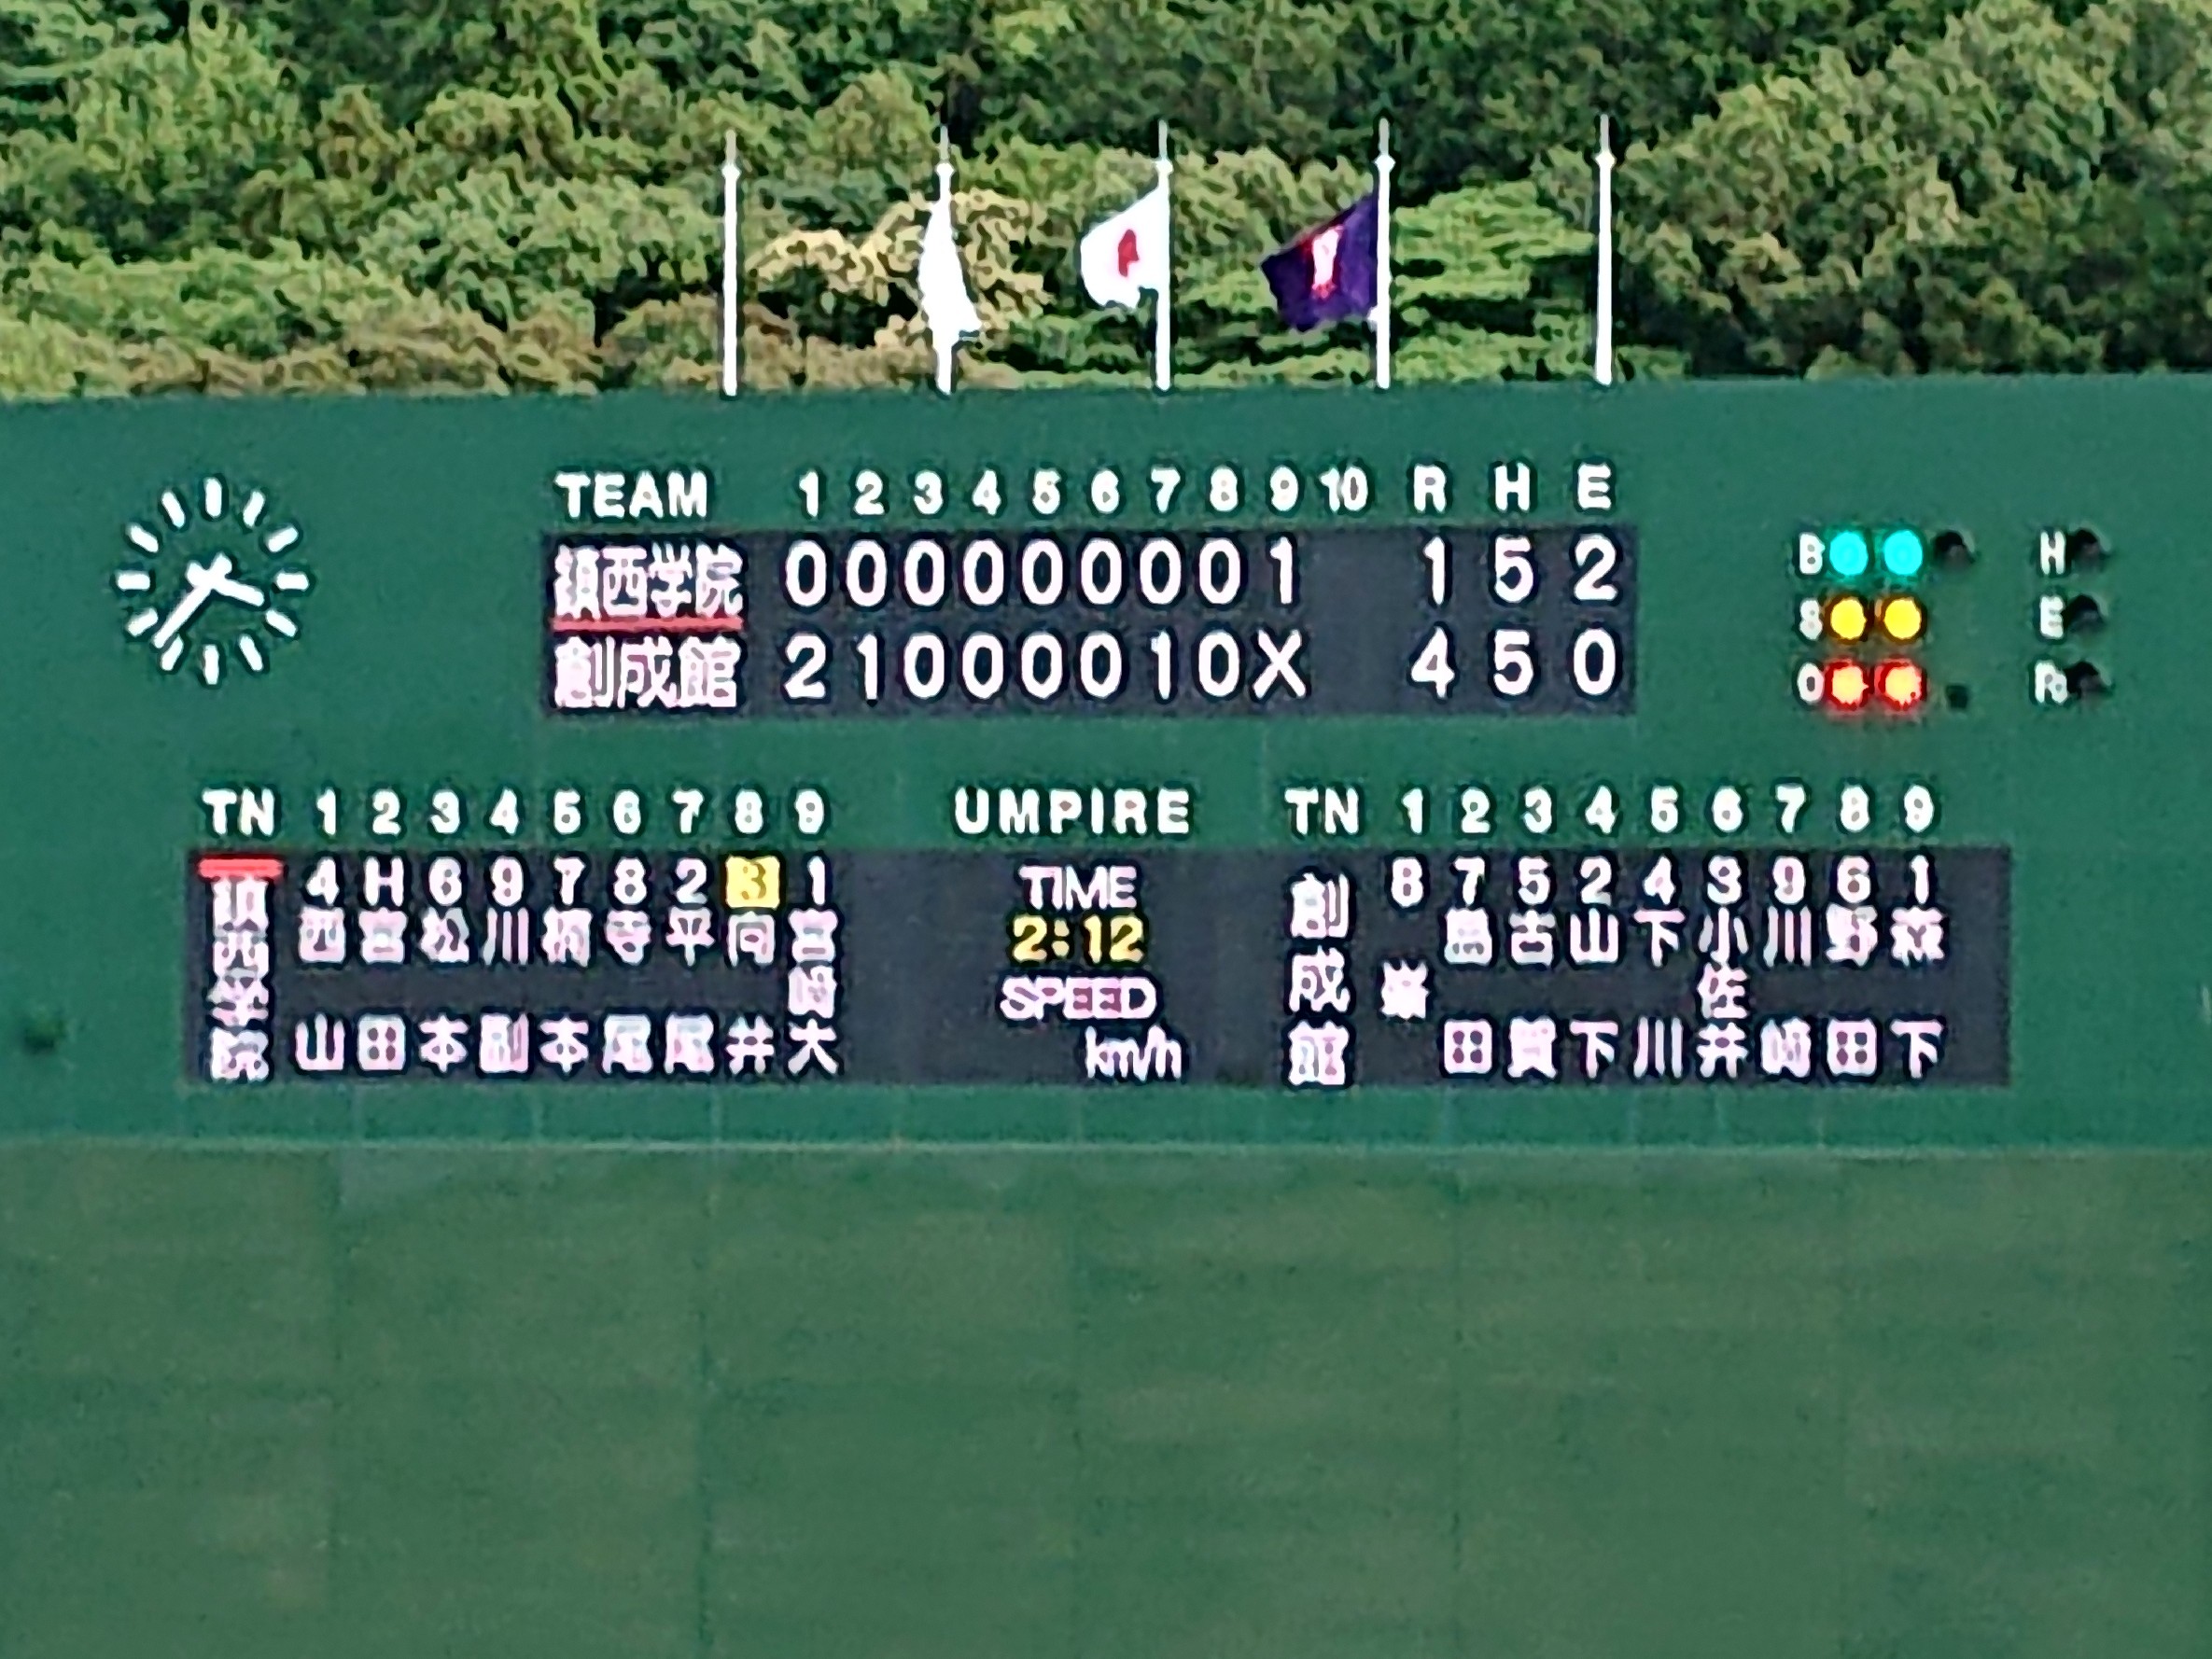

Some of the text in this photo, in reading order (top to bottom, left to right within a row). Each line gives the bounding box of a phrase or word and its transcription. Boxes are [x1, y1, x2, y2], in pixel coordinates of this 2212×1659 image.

[554, 463, 1611, 518] TEAM 1 2 3 4 5 6 7 8 9 10 R H E
[786, 535, 1617, 606] 0 0 0 0 0 0 0 0 1 1 5 2
[2040, 531, 2065, 575] H
[2040, 596, 2064, 638] E
[553, 635, 741, 708] 創成館
[785, 628, 1616, 699] 2 1 0 0 0 0 1 0 X 4 5 0
[202, 788, 824, 836] TN 1 2 3 4 5 6 7 8 9
[955, 788, 1189, 834] UMPIRE
[1284, 786, 1933, 835] TN 1 2 3 4 5 6 7 8 9
[307, 858, 339, 905] 4
[365, 857, 403, 906] H
[429, 858, 462, 906] 6
[491, 857, 523, 906] 9
[554, 857, 584, 905] 7
[614, 858, 647, 905] 8
[677, 858, 707, 903] 2
[809, 857, 825, 905] 1
[1018, 865, 1138, 911] TIME
[1392, 856, 1928, 907] 8 7 5 2 4 3 9 6 1
[1013, 915, 1143, 963] 2:12
[1000, 977, 1157, 1020] SPEED
[1288, 872, 1350, 1086] 創成館
[1570, 908, 1618, 1079] 山下
